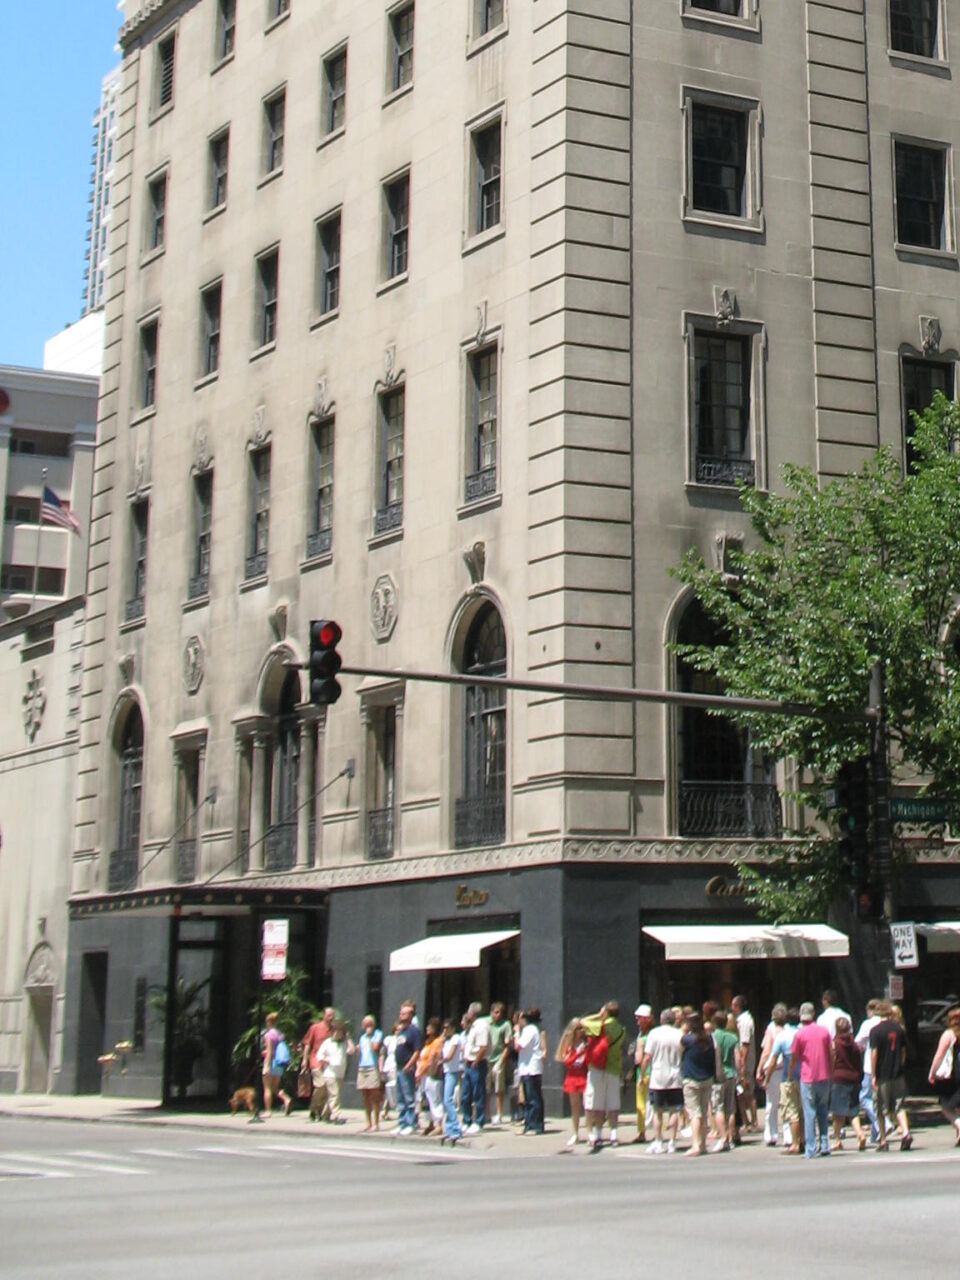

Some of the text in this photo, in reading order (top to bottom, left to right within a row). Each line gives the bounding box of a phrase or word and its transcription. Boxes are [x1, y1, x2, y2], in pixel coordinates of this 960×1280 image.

[897, 804, 936, 818] Michigan
[893, 926, 912, 938] ONE
[894, 938, 913, 950] WAY
